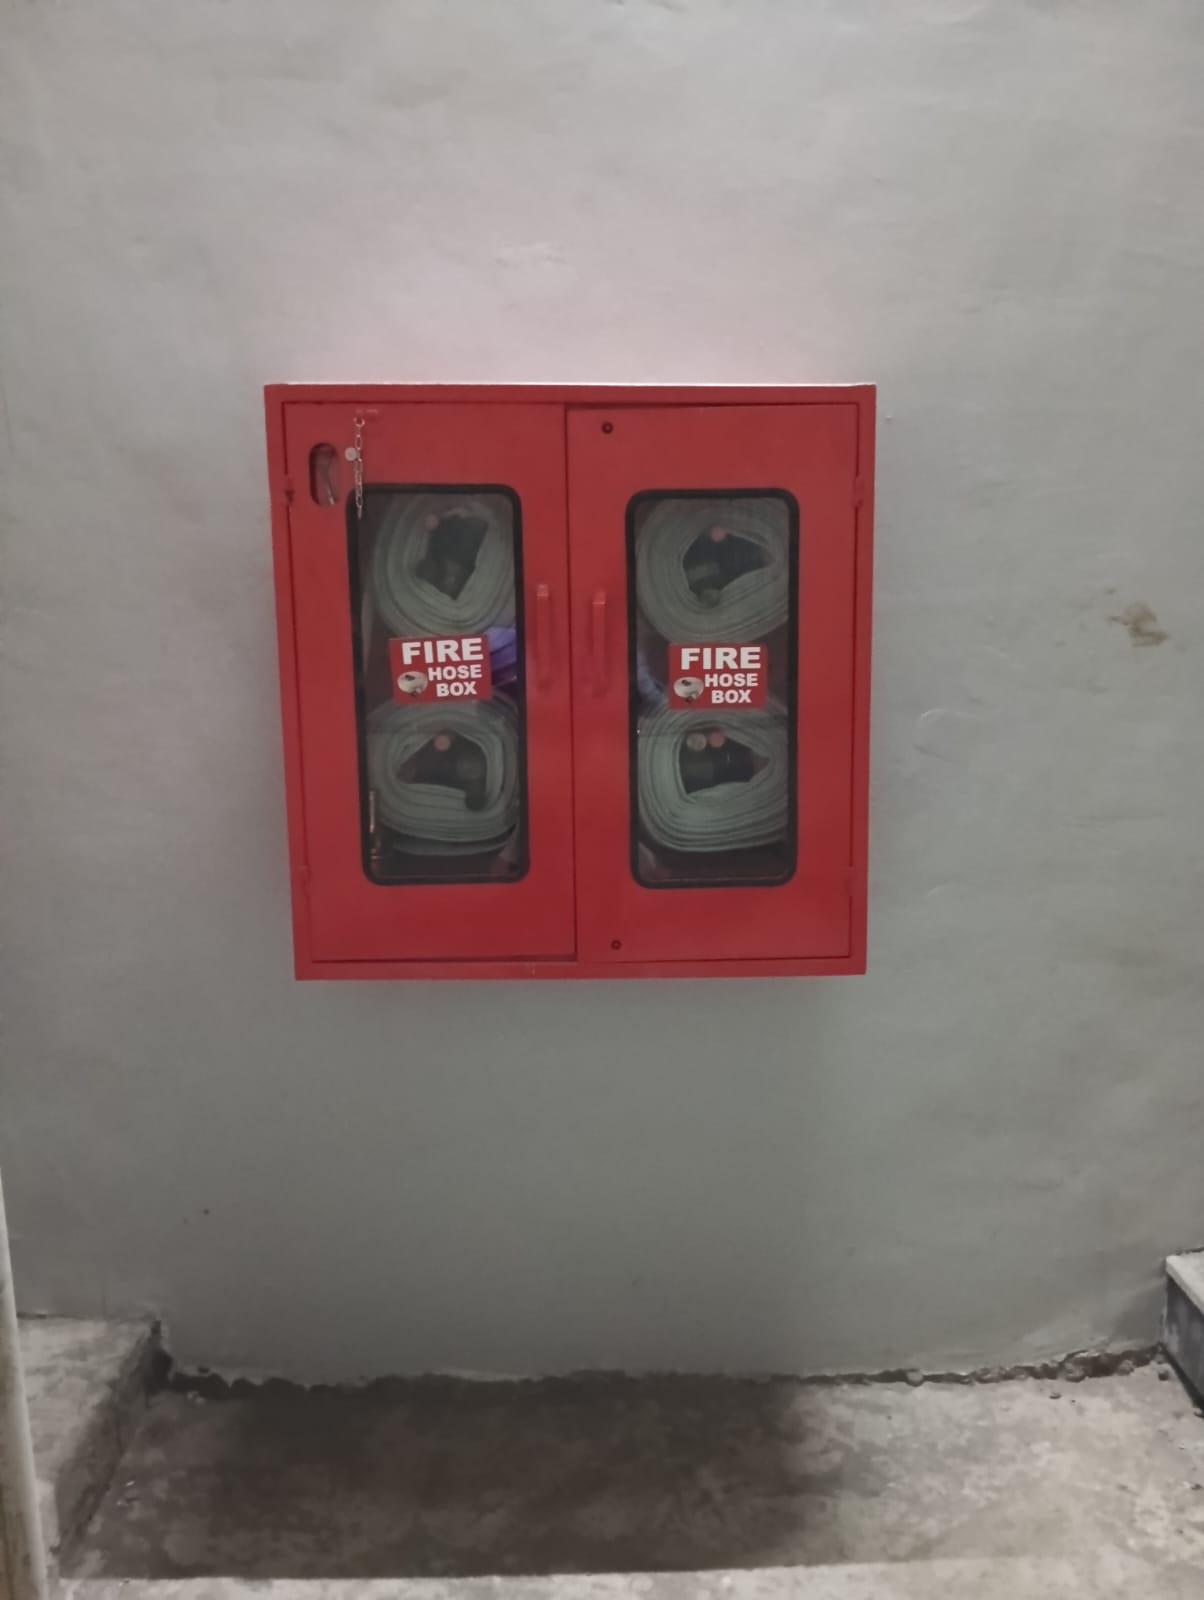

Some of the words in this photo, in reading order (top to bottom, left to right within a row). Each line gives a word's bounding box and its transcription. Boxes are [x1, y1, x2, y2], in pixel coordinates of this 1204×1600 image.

[401, 638, 483, 664] FIRE
[680, 646, 761, 669] FIRE
[427, 664, 482, 681] HOSE
[704, 673, 759, 688] HOSE
[436, 681, 477, 697] BOX
[711, 689, 752, 704] BOX
